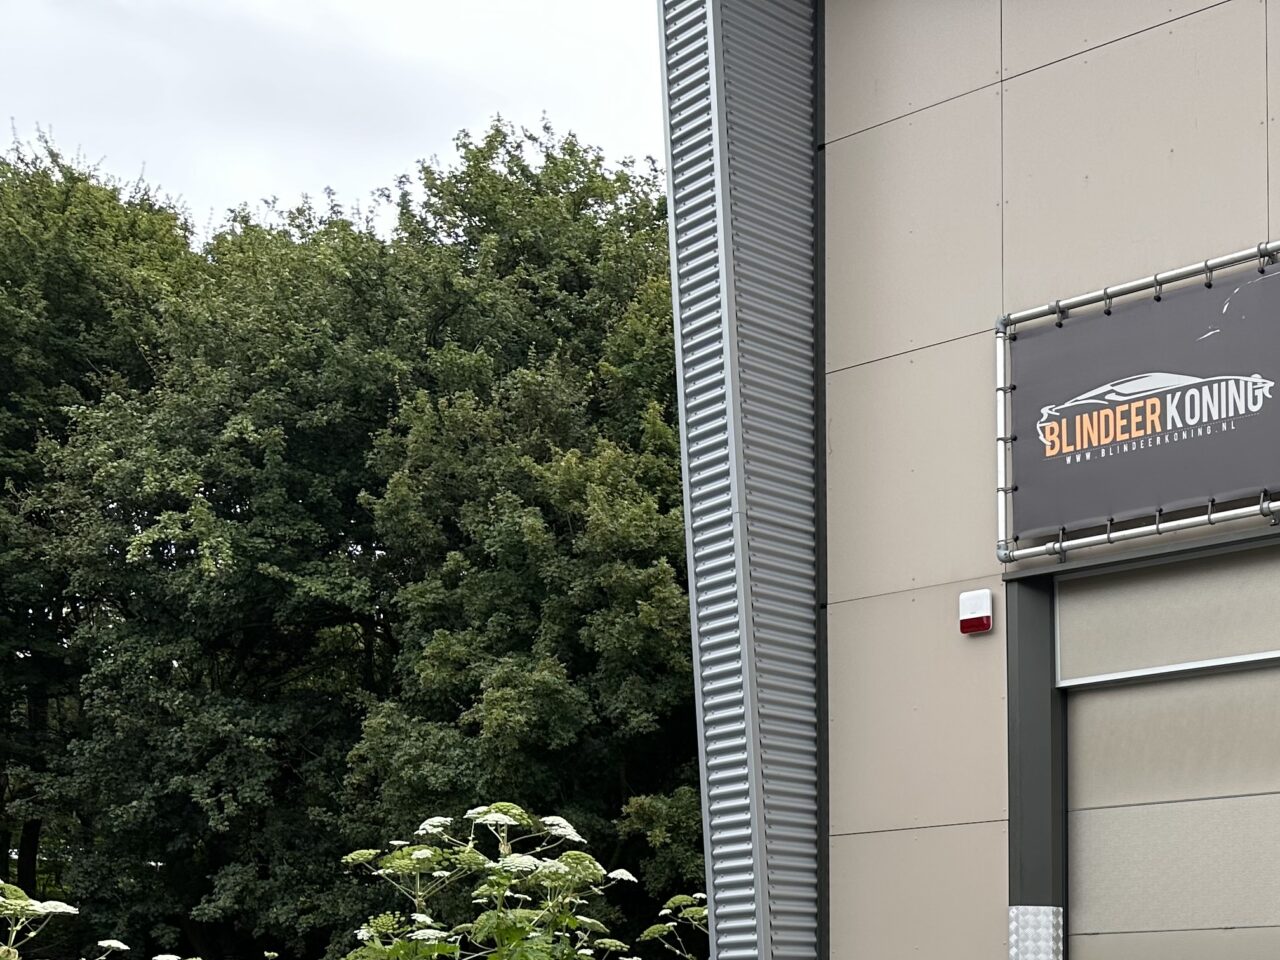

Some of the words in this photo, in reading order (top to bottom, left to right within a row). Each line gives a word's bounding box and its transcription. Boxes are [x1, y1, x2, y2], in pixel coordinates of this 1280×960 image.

[1045, 398, 1162, 457] BLINDEER
[1166, 374, 1264, 431] KONING
[1066, 421, 1237, 465] WWW.BLINDEERKONING.NL
